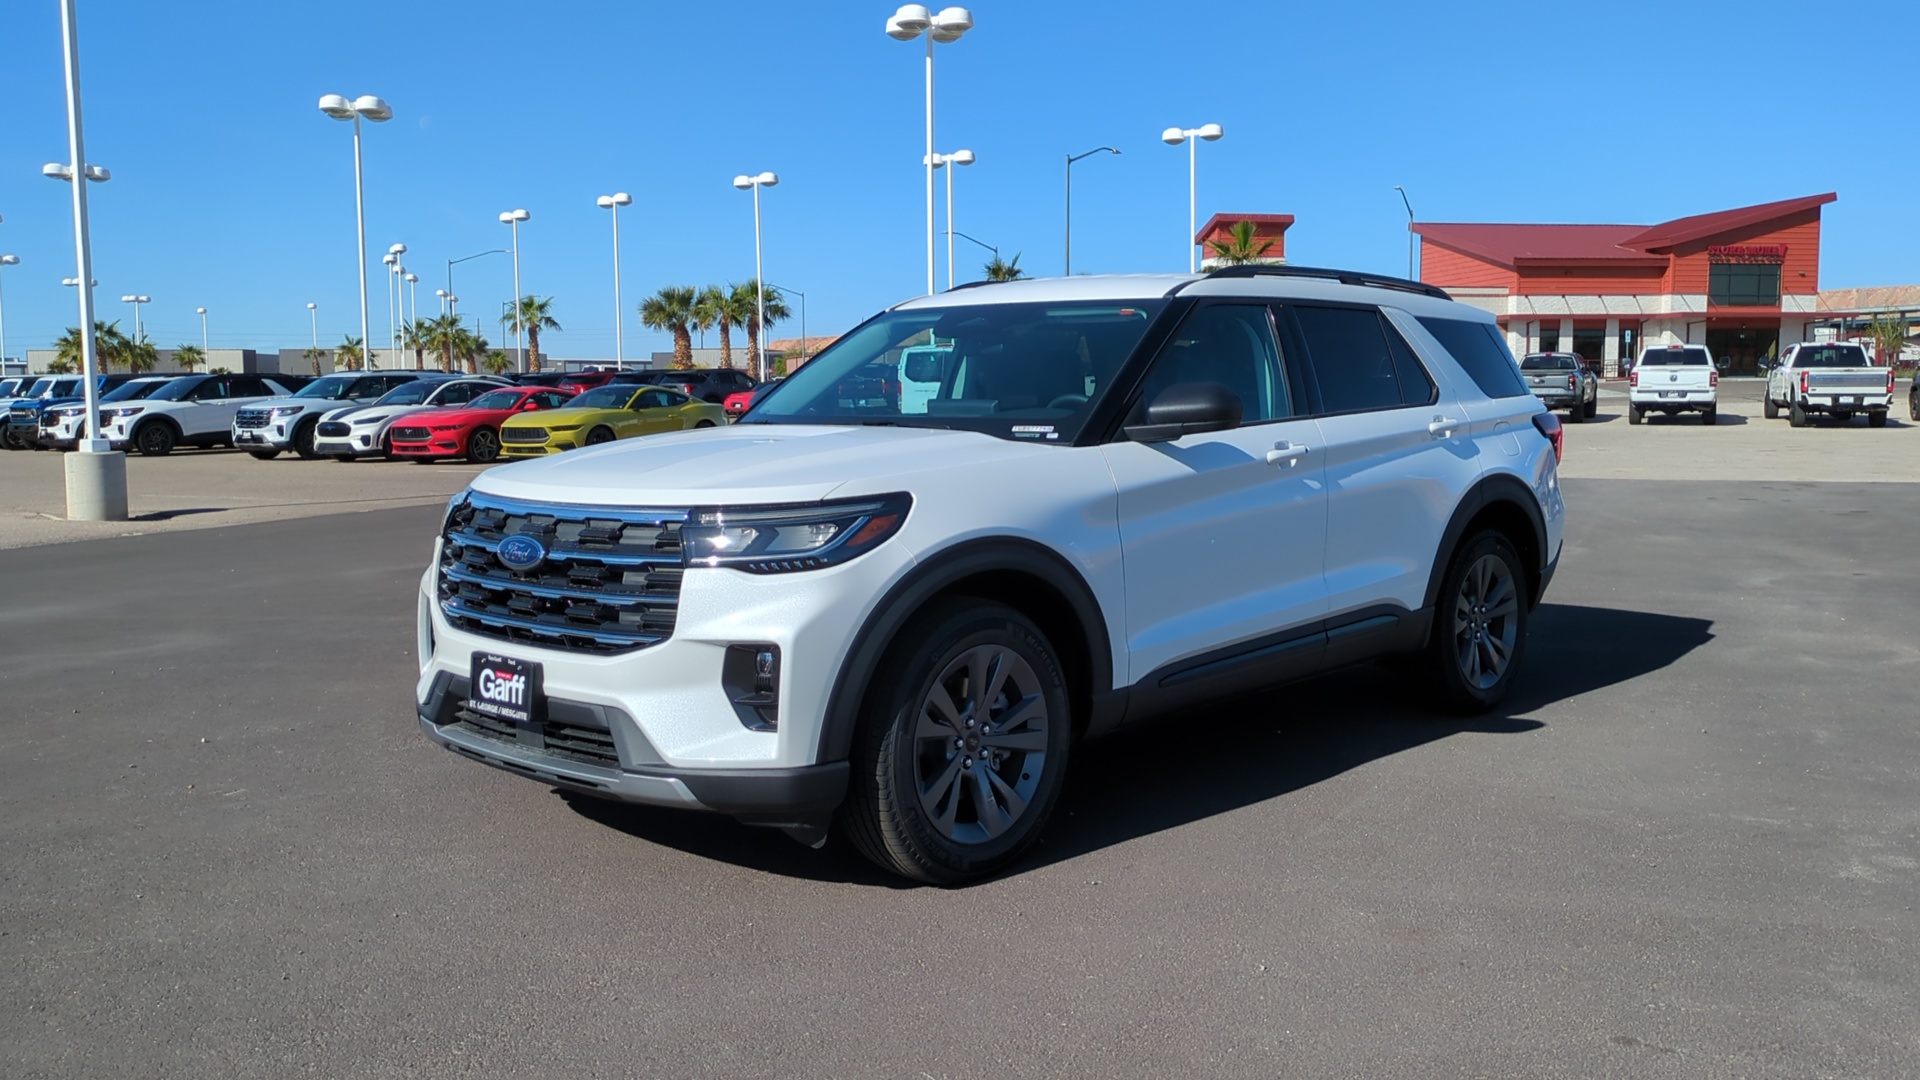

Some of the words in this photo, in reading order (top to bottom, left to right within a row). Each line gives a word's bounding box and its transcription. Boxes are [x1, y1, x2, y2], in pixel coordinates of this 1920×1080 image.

[1708, 245, 1745, 255] STORE
[505, 541, 531, 561] Ford
[1025, 635, 1060, 686] MICHELIN
[479, 668, 526, 705] Garff
